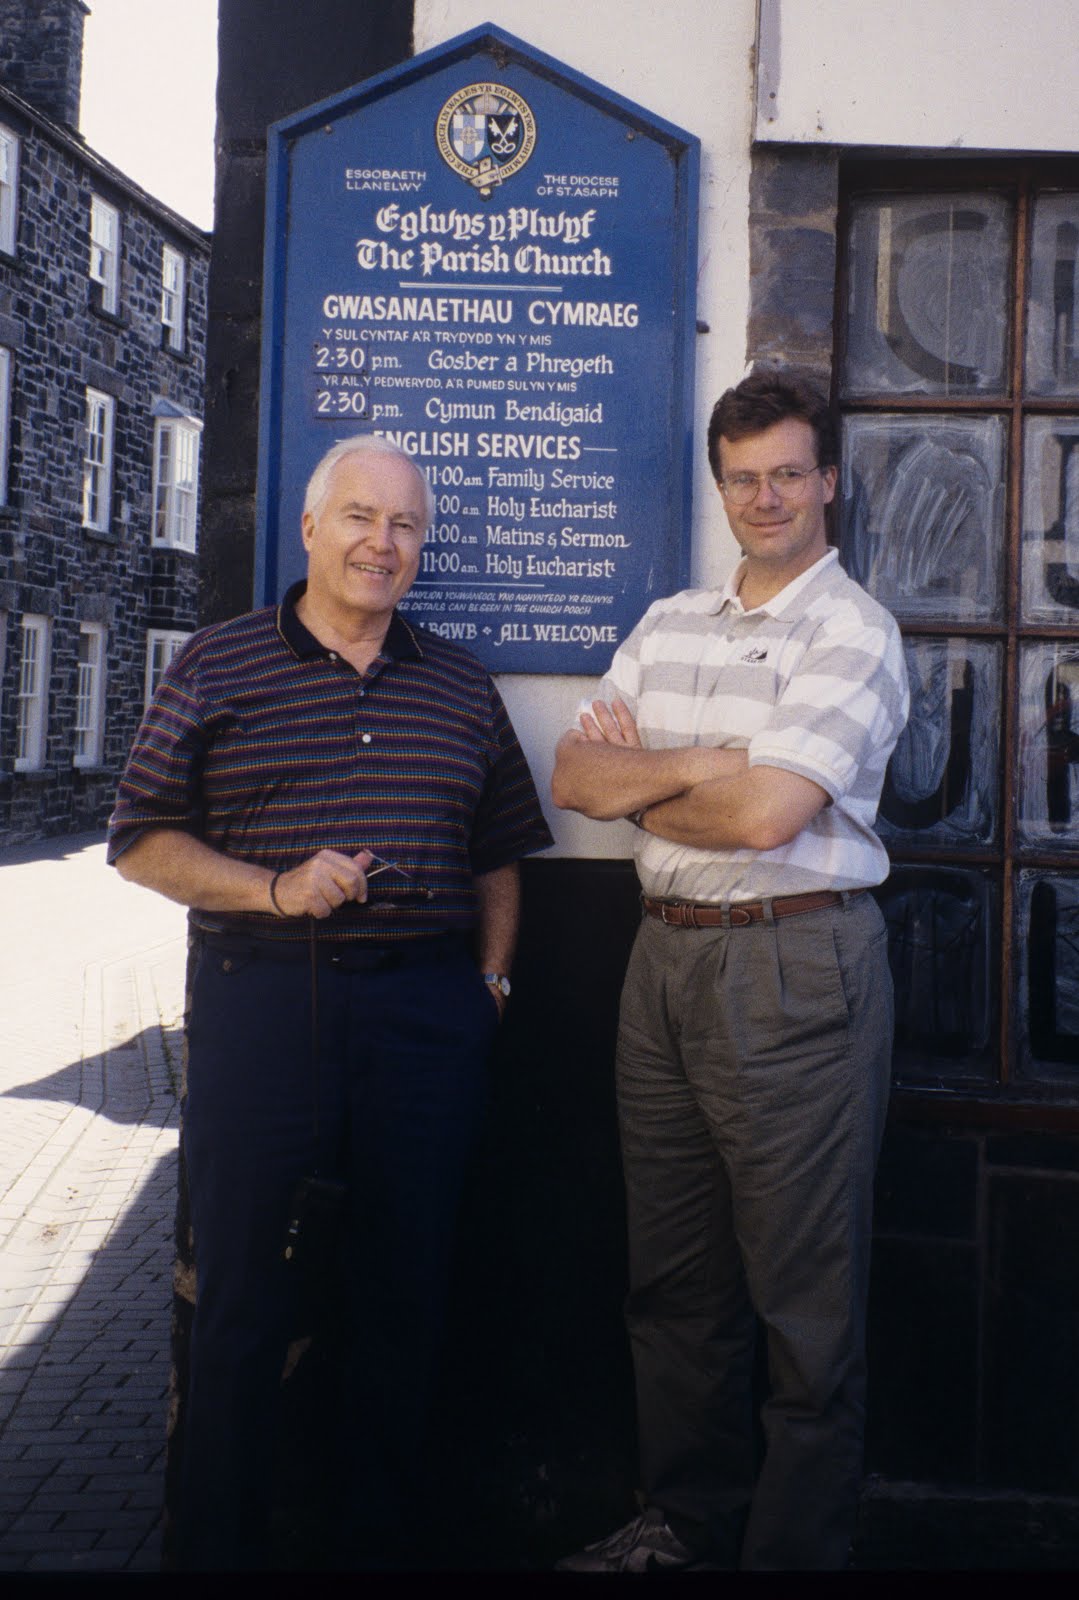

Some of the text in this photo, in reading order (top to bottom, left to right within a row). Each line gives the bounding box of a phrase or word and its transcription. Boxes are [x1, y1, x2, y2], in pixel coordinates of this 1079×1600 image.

[494, 86, 528, 113] EGLWYS
[441, 111, 449, 123] IN
[524, 112, 534, 135] YNG
[438, 123, 456, 165] CHURCH
[346, 169, 427, 181] ESGOBAETH
[455, 161, 475, 176] THE
[544, 174, 619, 186] THE DIOCESE
[346, 181, 422, 192] LLANELWY
[536, 186, 553, 196] OF
[376, 204, 486, 241] Eglwys
[507, 208, 597, 244] Plwyf
[355, 239, 613, 277] The Parish Church
[323, 295, 640, 328] GWASANAETHAU CYMRAEG
[322, 329, 332, 340] Y
[335, 329, 358, 341] SUL
[360, 330, 409, 342] CYNTAF
[434, 332, 493, 345] TRYDYDD
[497, 334, 515, 345] YN
[519, 335, 527, 345] Y
[530, 335, 552, 346] MIS
[428, 349, 499, 372] Gosber
[505, 355, 518, 372] a
[526, 352, 614, 378] Phregeth
[322, 375, 338, 386] YR
[363, 377, 372, 387] Y
[466, 379, 505, 390] PUMED
[507, 380, 528, 391] SUL
[529, 381, 545, 391] YN
[547, 382, 555, 392] Y
[557, 382, 577, 392] MIS
[425, 397, 496, 424] Cymun
[505, 401, 603, 427] Bendigaid
[477, 434, 581, 460] SERVICES
[488, 467, 544, 491] Family
[551, 469, 615, 490] Service
[487, 496, 525, 521] Holy
[530, 498, 617, 519] Eucharist
[486, 525, 544, 547] Matins
[561, 527, 632, 548] Sermon
[485, 553, 522, 578] Holy
[526, 555, 615, 578] Eucharist
[411, 602, 446, 612] DETAILS
[448, 603, 467, 612] CAN
[467, 603, 480, 613] BE
[479, 604, 502, 613] SEEN
[501, 604, 513, 613] IN
[513, 604, 529, 613] THE
[528, 605, 562, 614] CHURCH
[563, 605, 592, 615] PORCH
[568, 594, 580, 603] YR
[494, 624, 532, 646] ALL
[532, 625, 618, 648] WELCOME
